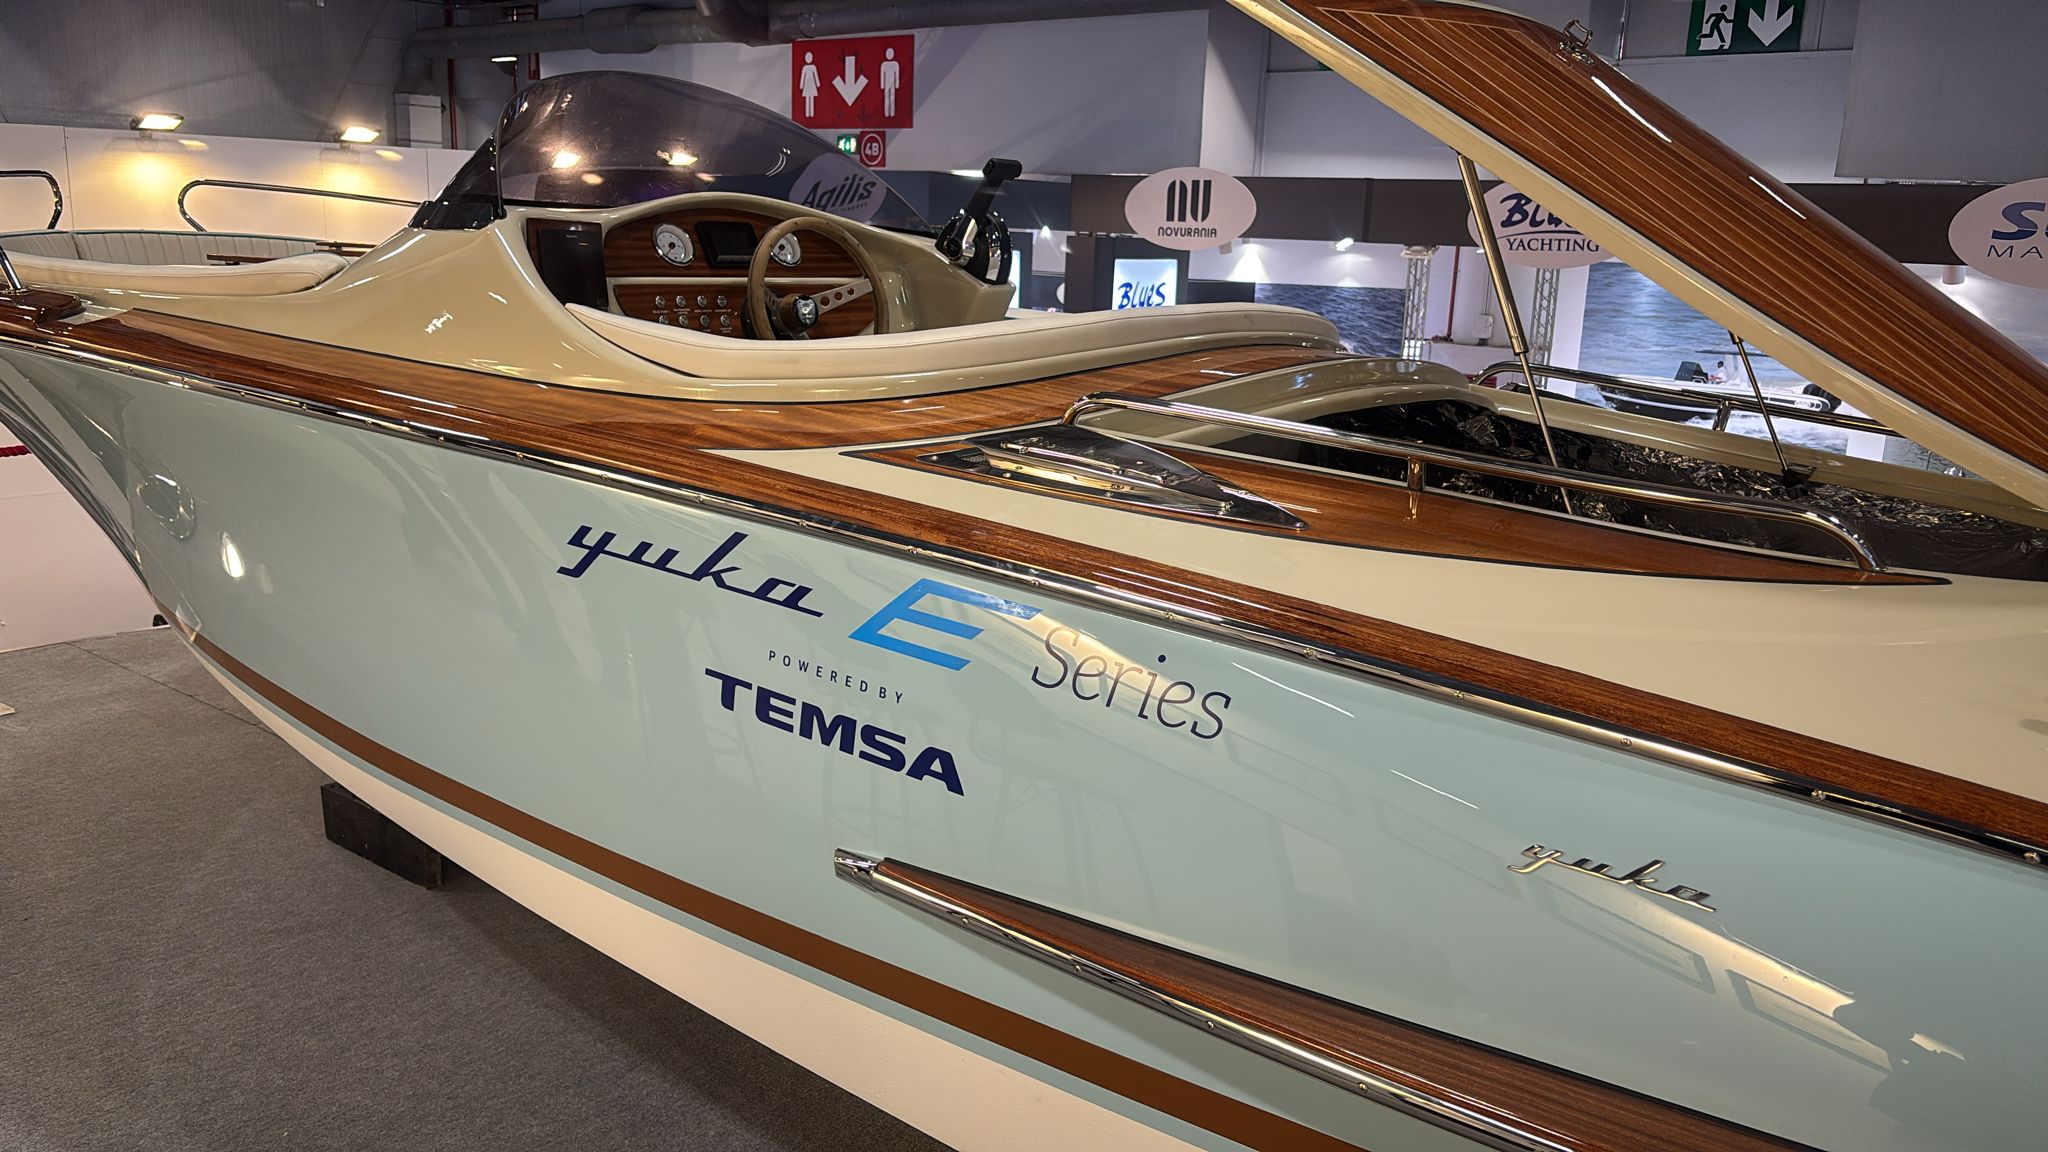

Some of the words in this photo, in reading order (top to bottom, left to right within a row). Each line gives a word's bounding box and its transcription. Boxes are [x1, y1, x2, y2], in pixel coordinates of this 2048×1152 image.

[864, 142, 880, 156] 4B
[1157, 226, 1217, 238] NOVURANIA
[1991, 201, 2048, 240] S
[1505, 238, 1600, 252] YACHTING
[556, 524, 824, 617] yuka
[847, 578, 1044, 671] E
[1031, 626, 1232, 740] Series
[767, 650, 869, 693] POWERED
[878, 686, 904, 704] BY
[704, 667, 965, 797] TEMSA
[1506, 844, 1717, 913] yuka
